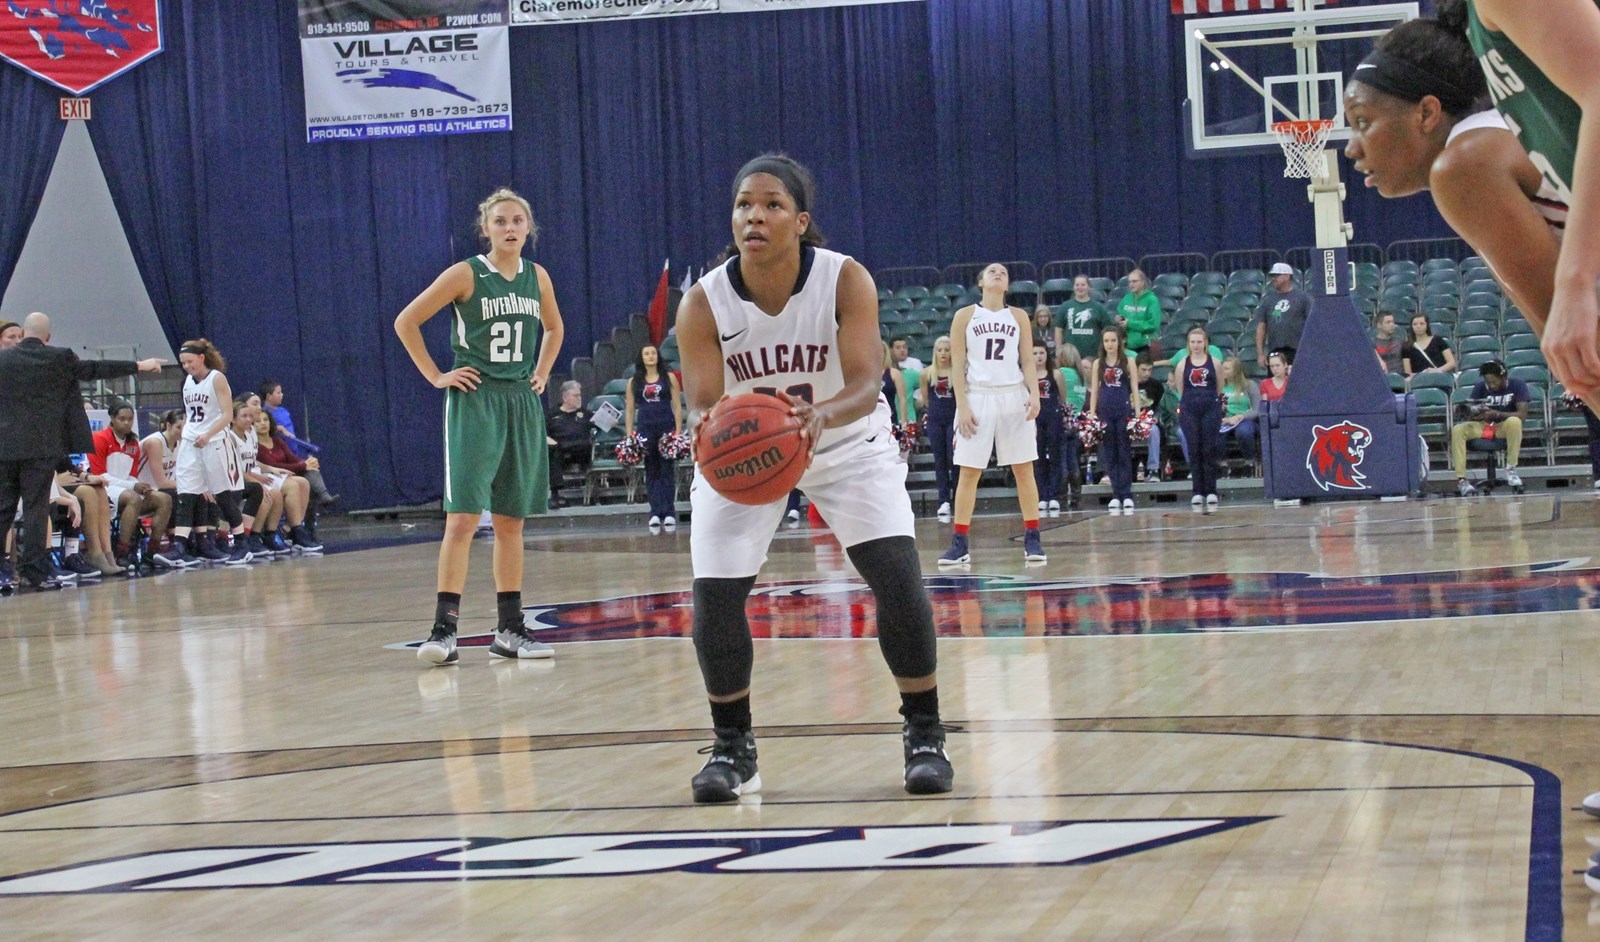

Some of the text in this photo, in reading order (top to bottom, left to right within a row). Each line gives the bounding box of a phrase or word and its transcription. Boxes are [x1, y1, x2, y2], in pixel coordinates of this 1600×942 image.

[307, 21, 370, 35] 918-341-9500
[446, 13, 502, 26] P2WOK.COM
[333, 33, 479, 59] VILLAGE
[335, 54, 479, 69] TOURS & TRAVEL
[61, 99, 90, 118] EXIT
[309, 103, 509, 123] WWW.VILLAGETOURS.NET 918-739-3673
[312, 119, 507, 140] PROUDLY SERVING RSU ATHLETICS
[972, 322, 1016, 337] HILLCATS
[489, 321, 523, 363] 21
[985, 338, 1006, 361] 12
[726, 344, 829, 383] HILLCATS
[189, 406, 205, 423] 25
[710, 418, 760, 449] NCAA
[713, 445, 786, 480] Wilson
